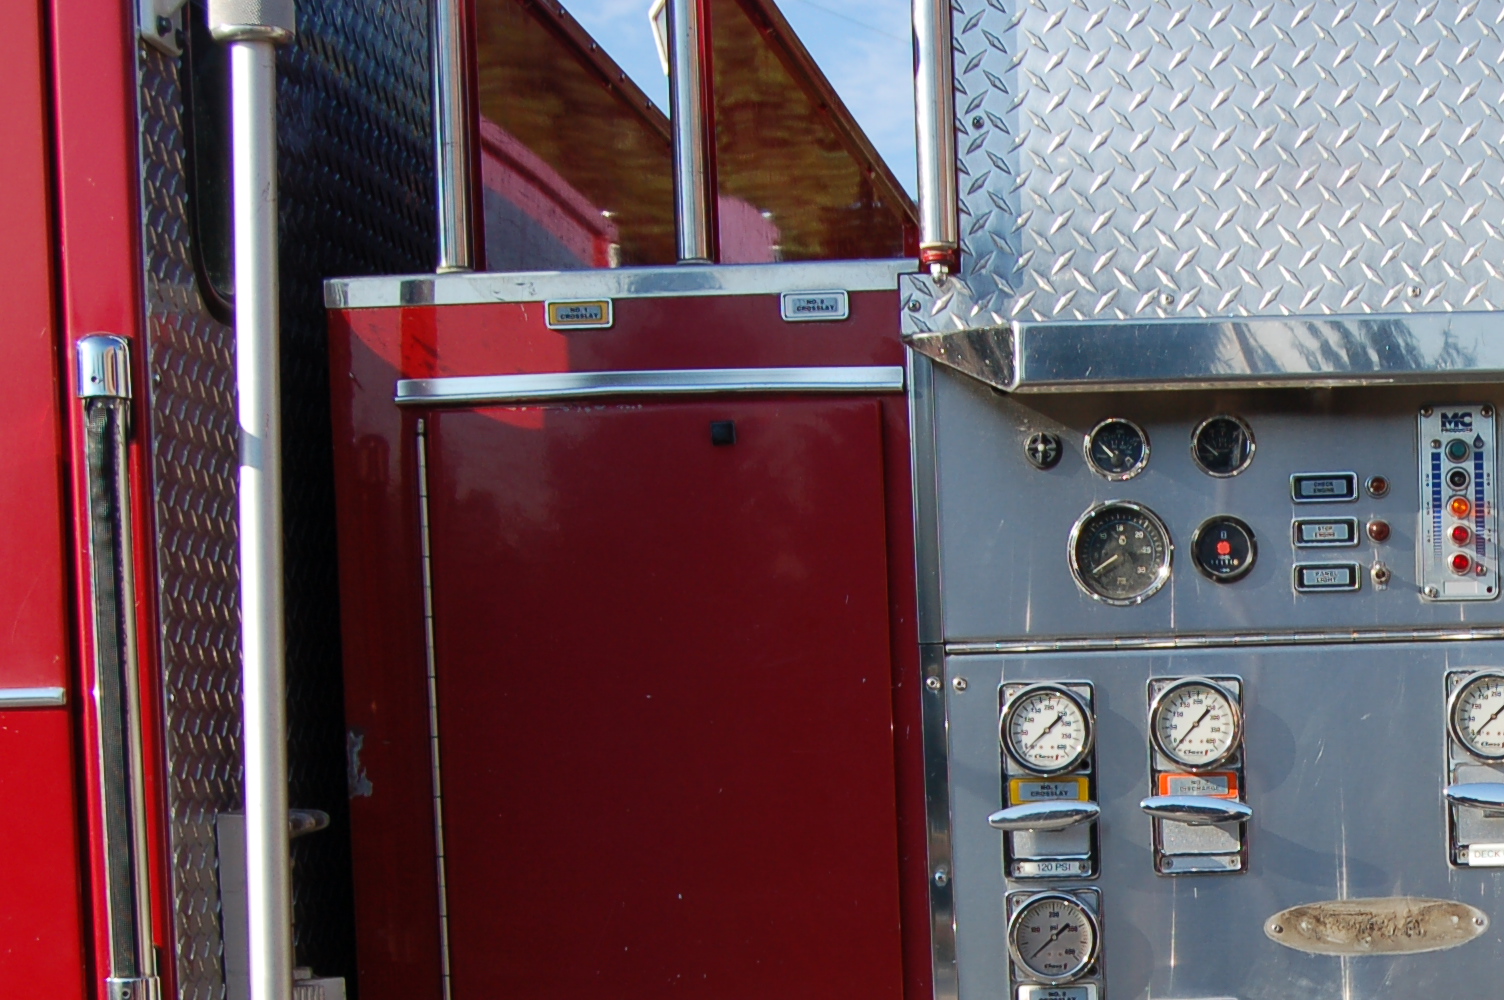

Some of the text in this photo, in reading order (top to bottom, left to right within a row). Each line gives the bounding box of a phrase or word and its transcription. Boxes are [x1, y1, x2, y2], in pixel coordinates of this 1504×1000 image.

[1441, 412, 1473, 428] MC
[1474, 850, 1500, 858] DECK
[1036, 864, 1071, 872] 120 PSI
